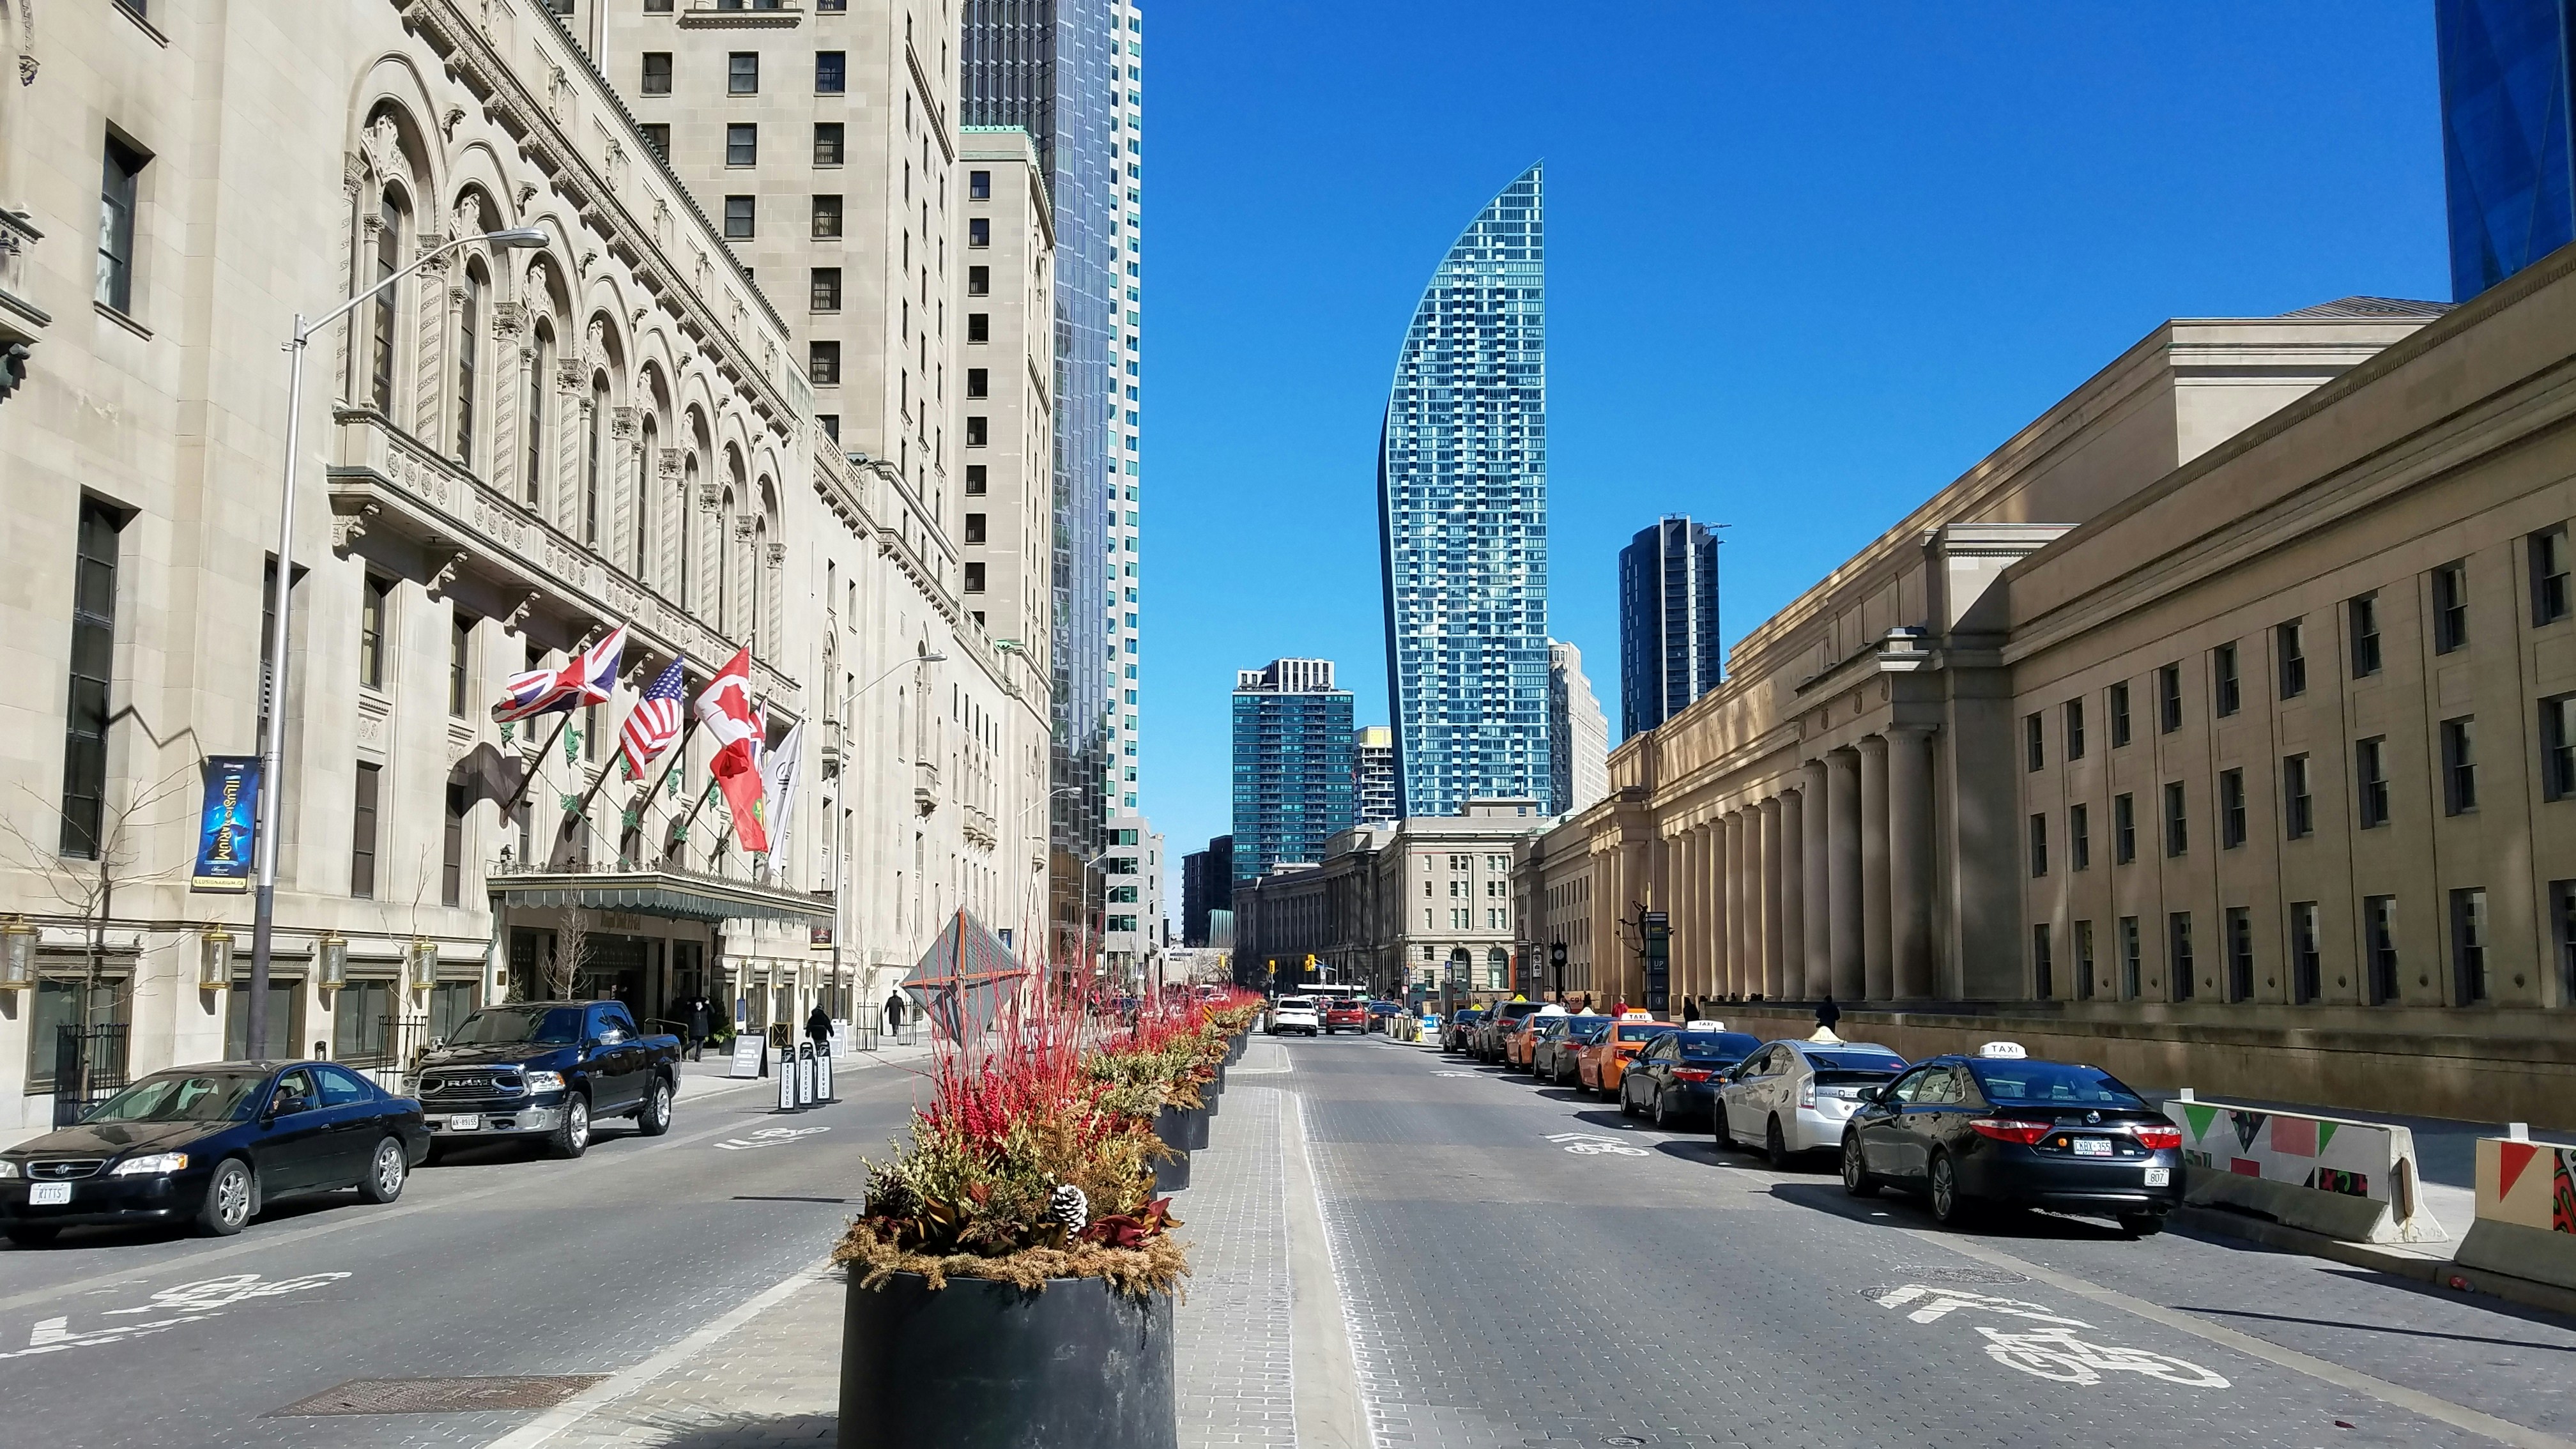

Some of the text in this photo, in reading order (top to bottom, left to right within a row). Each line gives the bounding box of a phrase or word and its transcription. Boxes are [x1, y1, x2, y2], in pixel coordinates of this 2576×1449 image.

[214, 781, 241, 861] ILLUSIONARIUM
[2150, 1173, 2164, 1183] 807
[38, 1188, 63, 1199] RITTS
